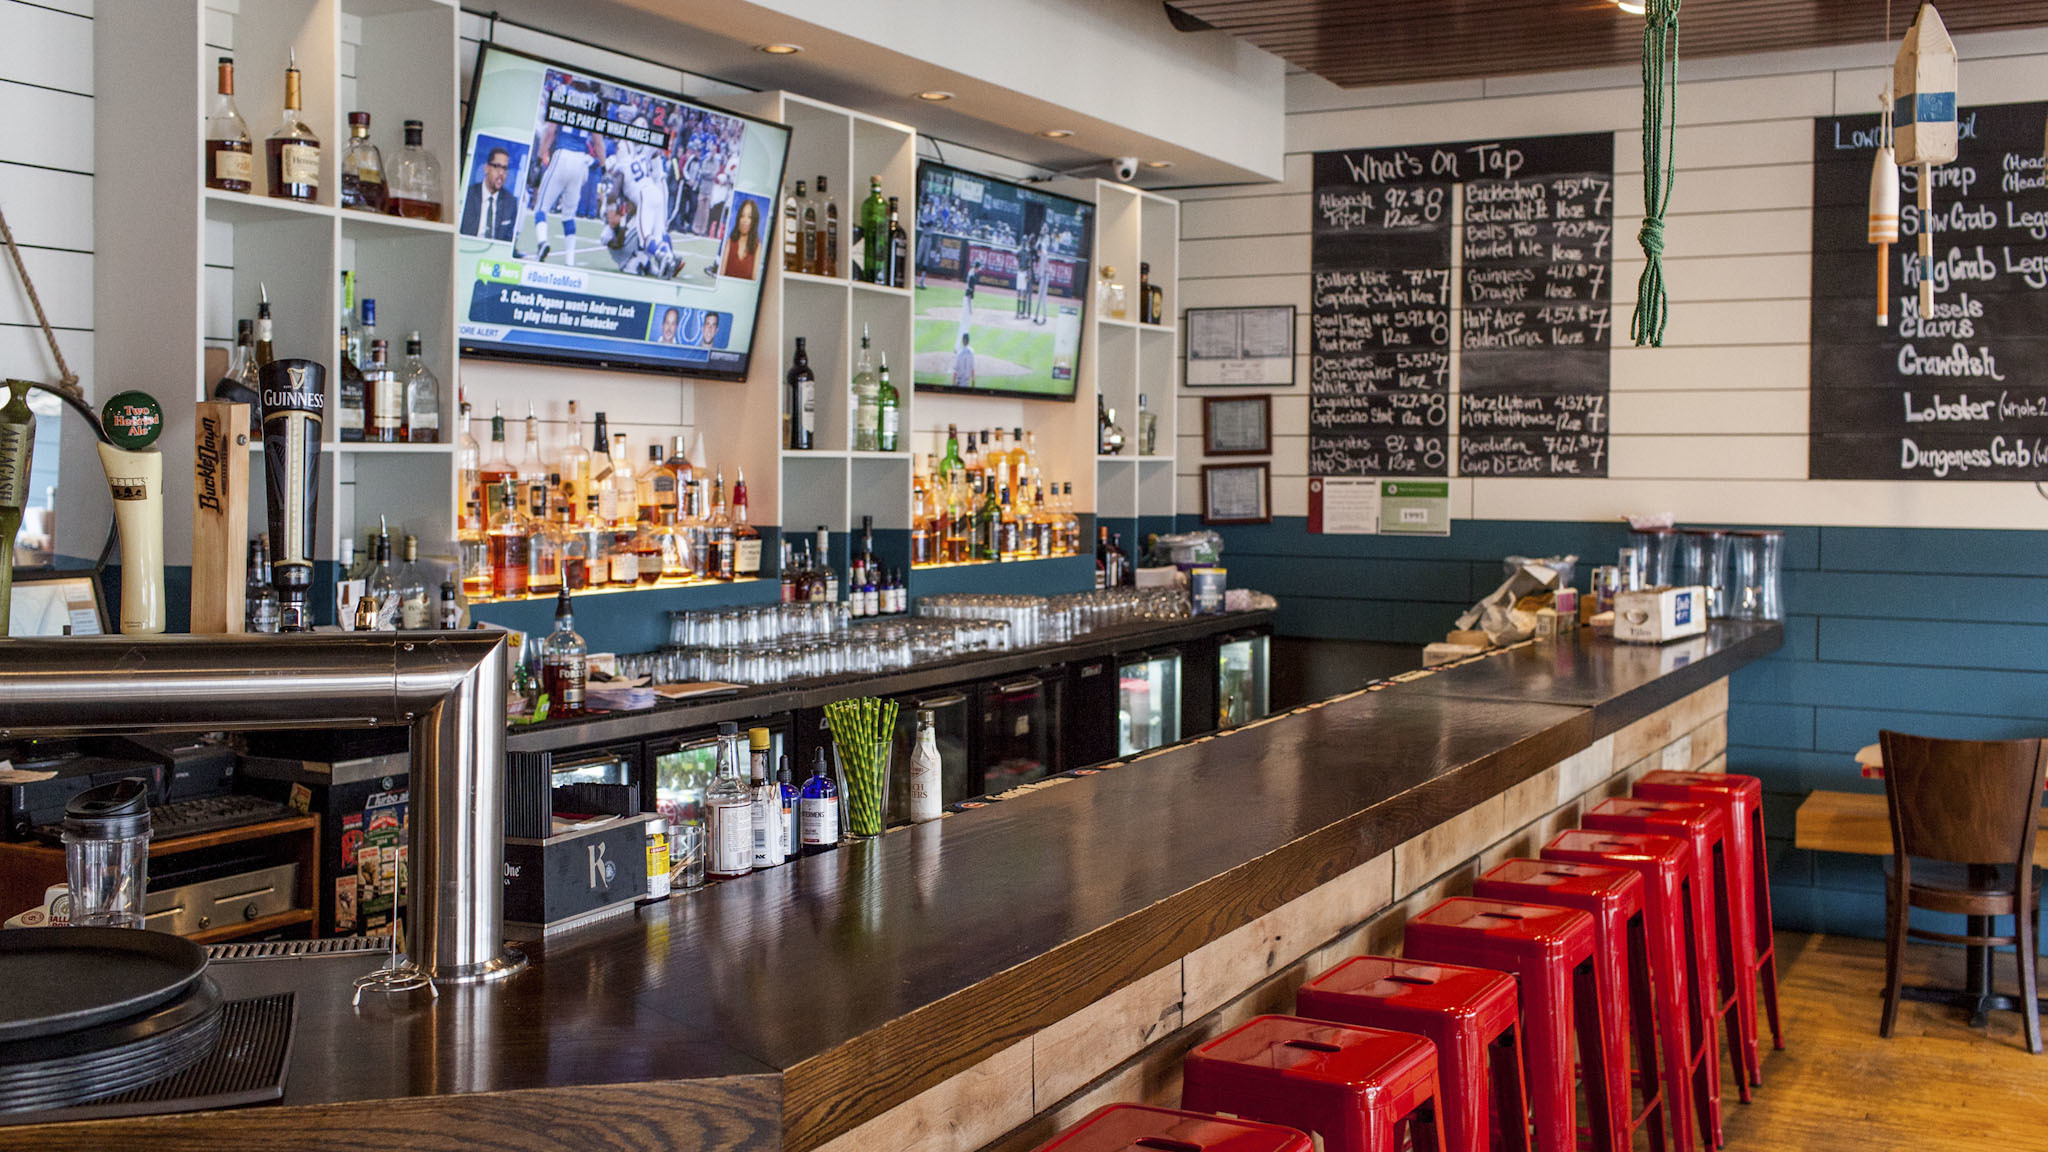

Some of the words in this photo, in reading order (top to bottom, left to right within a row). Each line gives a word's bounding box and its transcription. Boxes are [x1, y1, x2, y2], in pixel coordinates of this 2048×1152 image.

[549, 106, 566, 122] THIS
[567, 111, 576, 124] IS
[576, 113, 596, 129] PART
[596, 118, 607, 132] OF
[607, 120, 627, 137] WHAT
[1343, 150, 1423, 183] What's
[1431, 149, 1460, 178] On
[1465, 144, 1524, 179] Tap
[1901, 164, 1977, 196] Srimp
[1901, 205, 1948, 235] Sw
[1951, 201, 1997, 231] Crab
[1902, 252, 1950, 293] Kig
[1948, 245, 1997, 281] Crab
[511, 291, 535, 306] Chuck
[536, 294, 564, 311] Pagano
[565, 299, 588, 312] wants
[589, 301, 618, 316] Andrew
[513, 308, 523, 320] to
[523, 310, 540, 325] play
[1900, 292, 1984, 319] Mssels
[1900, 317, 1975, 338] Clams
[1898, 343, 2005, 381] Crawfish
[123, 406, 149, 416] Two
[264, 389, 324, 408] GUINNESS
[1904, 391, 1996, 422] Lobster
[114, 414, 159, 426] Hearted
[128, 426, 149, 436] Ale
[1901, 437, 1993, 478] Dungeness
[1991, 436, 2031, 468] Crab
